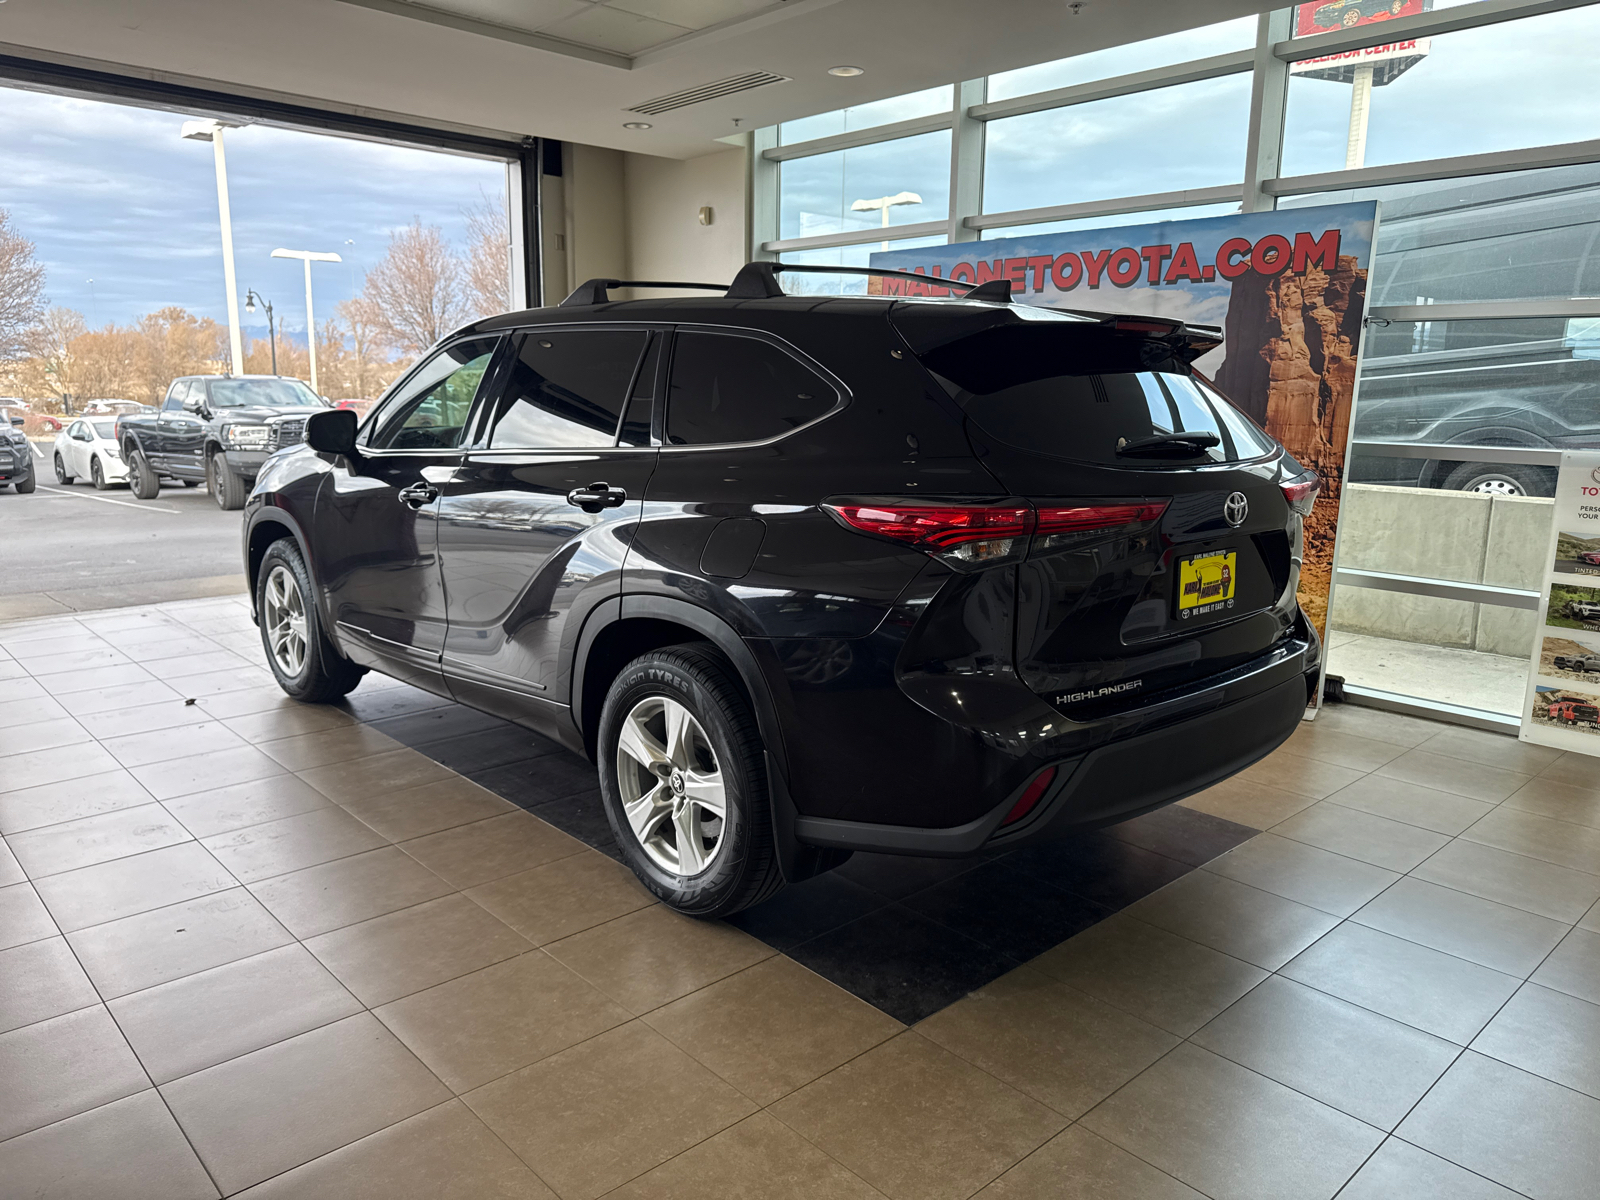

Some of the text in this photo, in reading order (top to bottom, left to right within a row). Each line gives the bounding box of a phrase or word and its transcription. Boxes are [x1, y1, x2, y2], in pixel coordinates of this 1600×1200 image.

[881, 229, 1341, 298] MALONETOYOTA.COM
[1580, 486, 1600, 497] TO
[1223, 569, 1228, 578] 32
[648, 669, 689, 693] TYRES
[1056, 679, 1142, 705] HIGHLANDER
